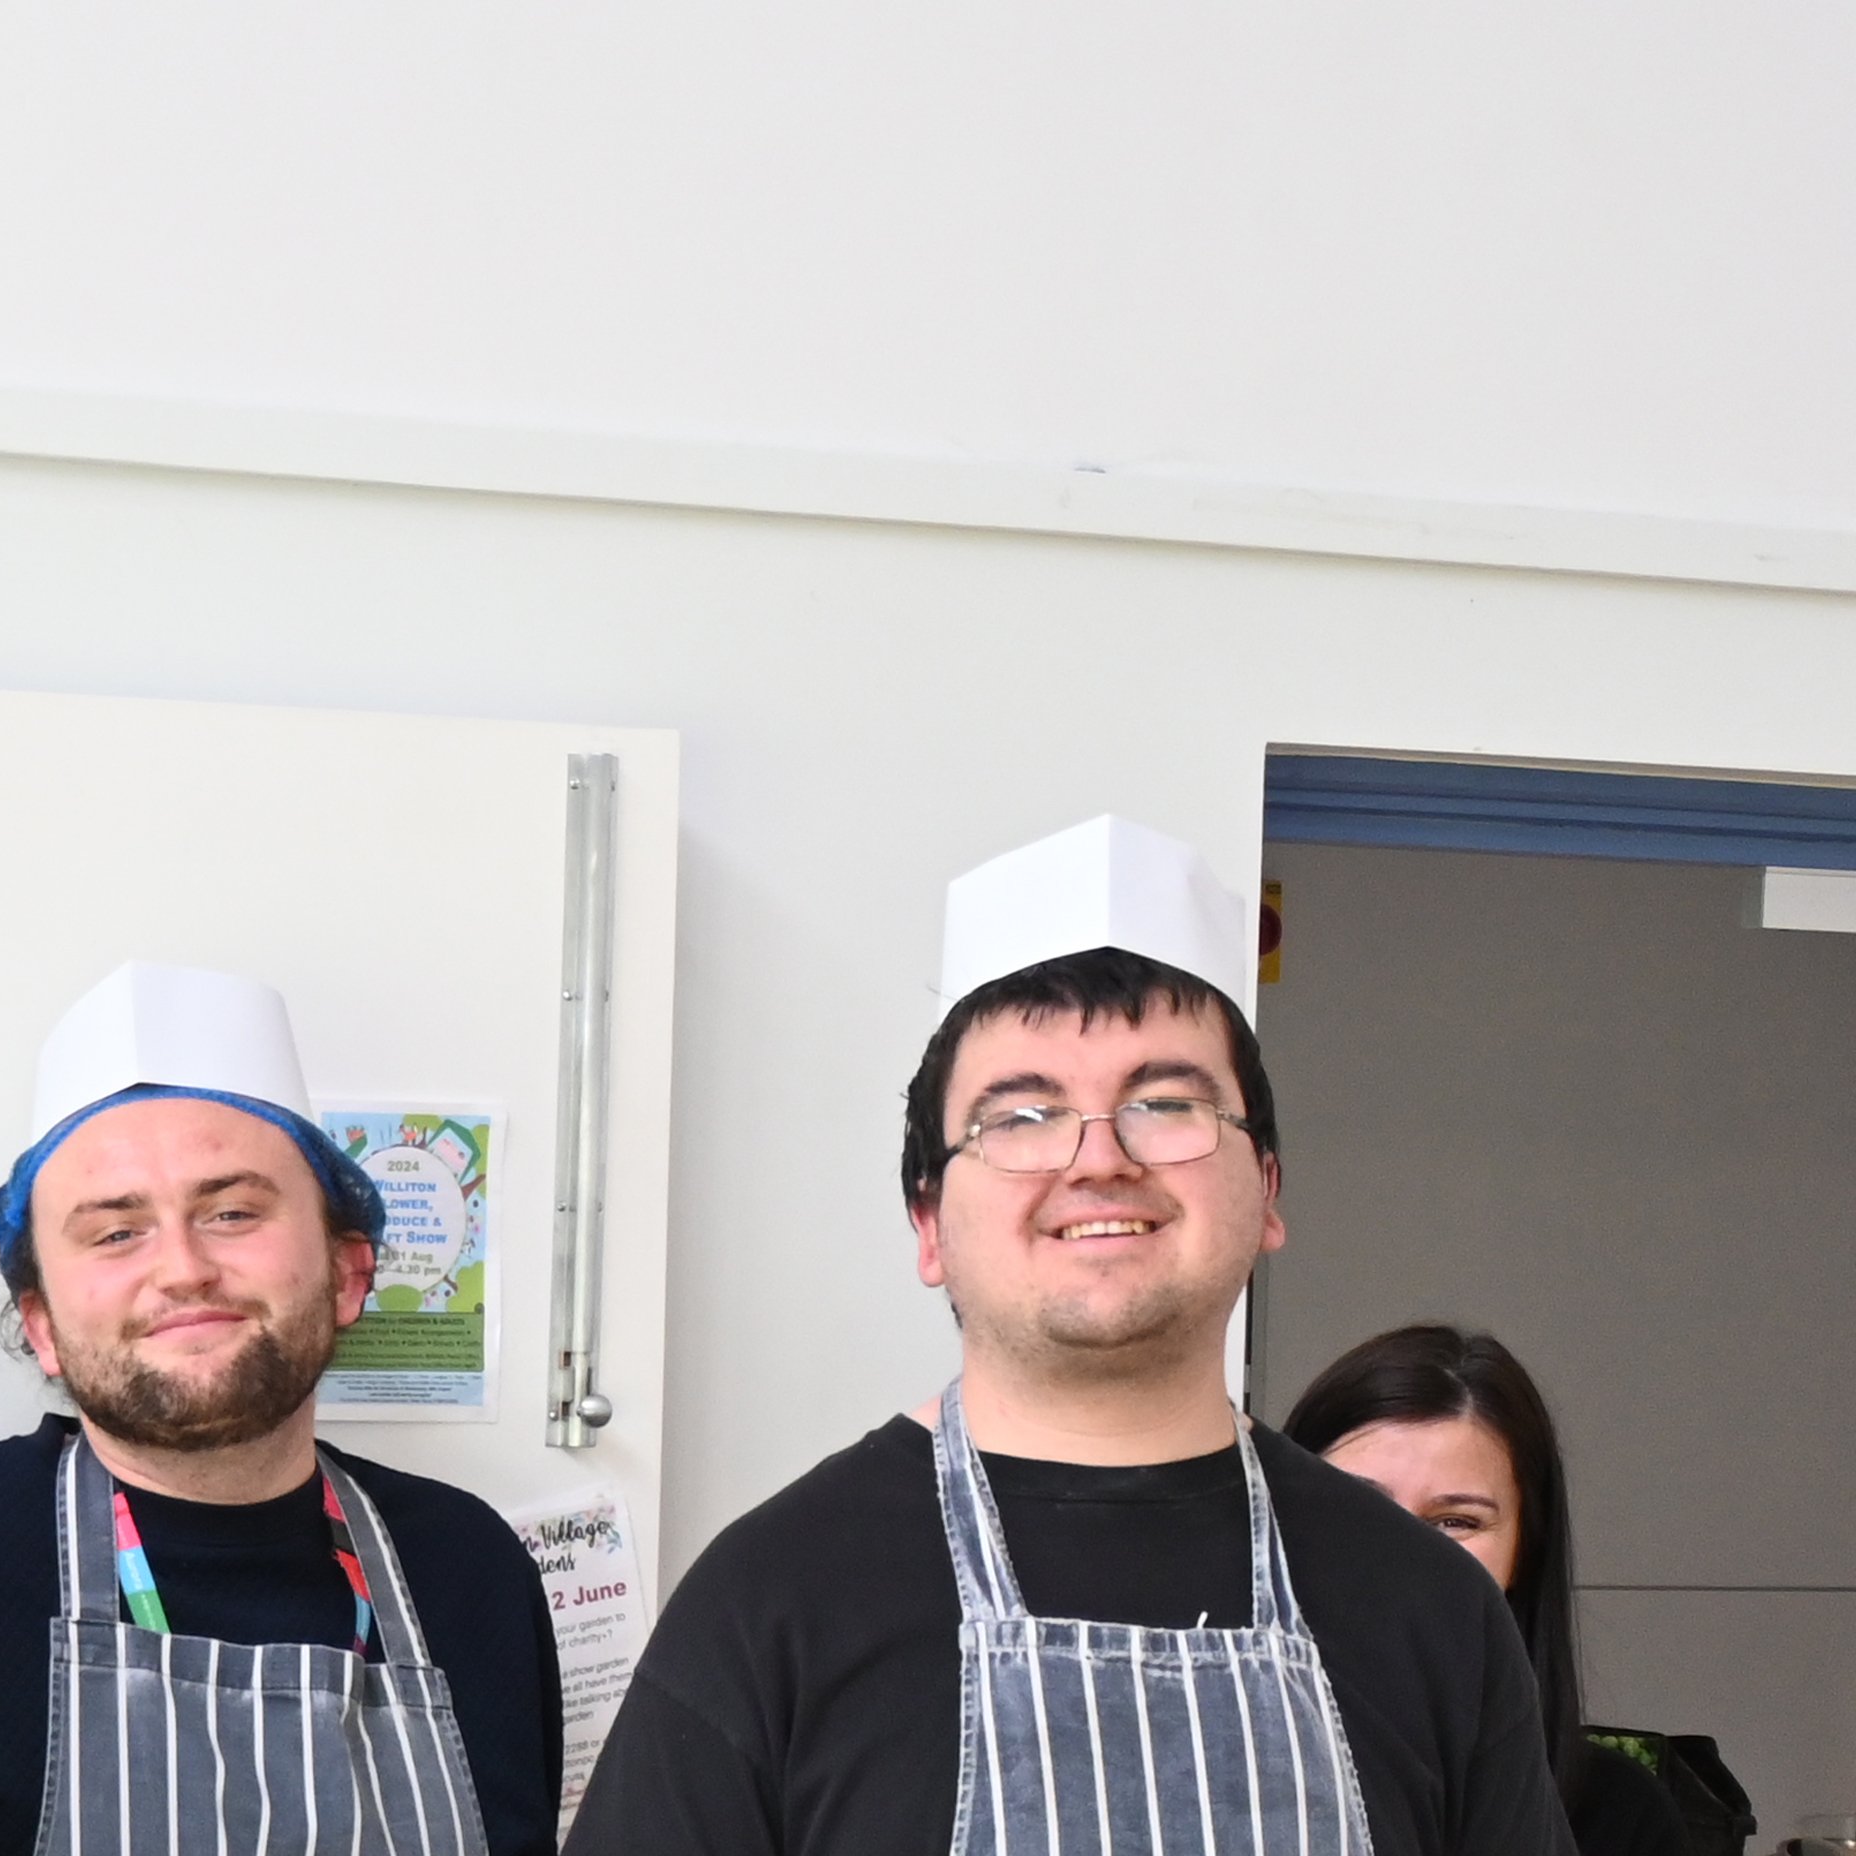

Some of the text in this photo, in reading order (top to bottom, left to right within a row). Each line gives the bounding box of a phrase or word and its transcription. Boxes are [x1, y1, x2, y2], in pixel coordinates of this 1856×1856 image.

[387, 1161, 420, 1172] 2024
[541, 1516, 610, 1549] Village
[538, 1553, 576, 1575] dens
[573, 1581, 627, 1606] June
[579, 1615, 614, 1632] garden
[615, 1612, 626, 1623] to
[596, 1656, 629, 1674] garden
[585, 1677, 608, 1690] have
